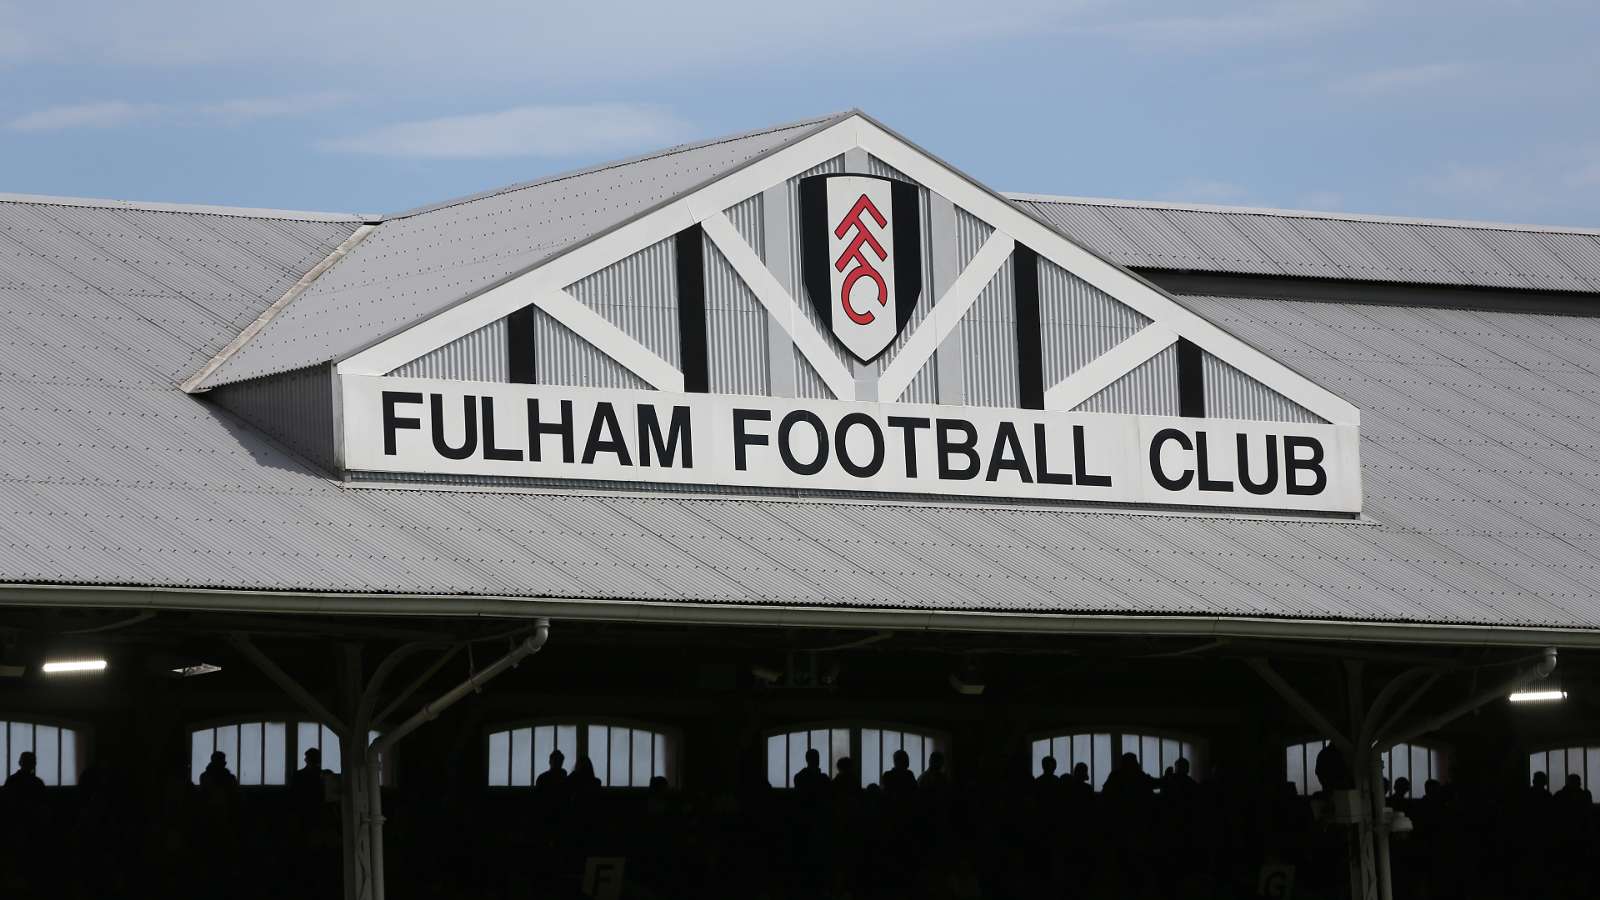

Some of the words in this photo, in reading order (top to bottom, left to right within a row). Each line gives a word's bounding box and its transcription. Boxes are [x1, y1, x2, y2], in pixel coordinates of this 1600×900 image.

[834, 193, 888, 325] FFC
[381, 390, 693, 469] FULHAM
[732, 408, 1113, 488] FOOTBALL
[1149, 428, 1327, 496] CLUB
[594, 864, 614, 896] F
